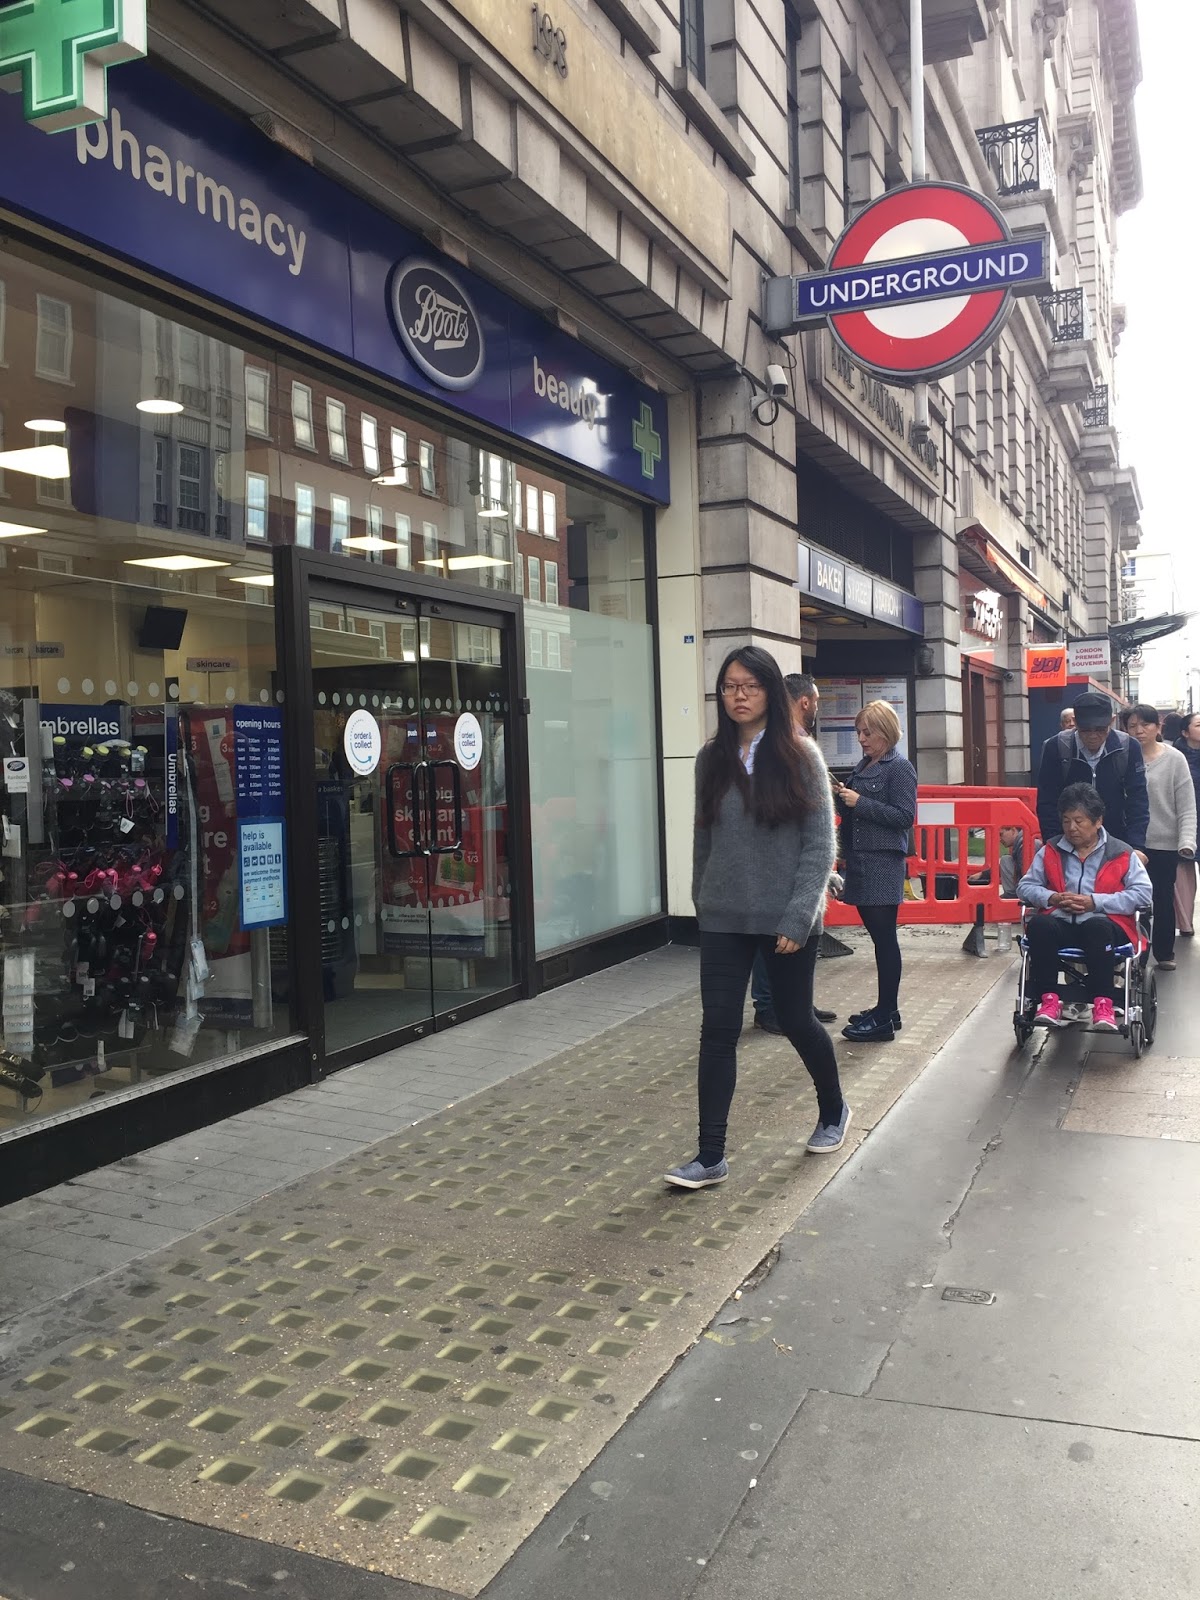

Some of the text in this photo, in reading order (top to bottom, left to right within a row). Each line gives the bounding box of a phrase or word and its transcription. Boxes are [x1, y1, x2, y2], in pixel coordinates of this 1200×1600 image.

[76, 108, 306, 276] pharmacy
[810, 253, 1029, 307] UNDERGROUND
[409, 284, 469, 351] Boots
[533, 356, 598, 431] beauty
[817, 560, 843, 596] BAKER
[875, 588, 899, 618] STATION
[196, 659, 231, 668] skincare
[236, 720, 281, 730] opening hours
[354, 740, 372, 748] collect
[167, 753, 178, 815] Umbrellas
[243, 830, 265, 842] help is
[243, 841, 272, 853] available
